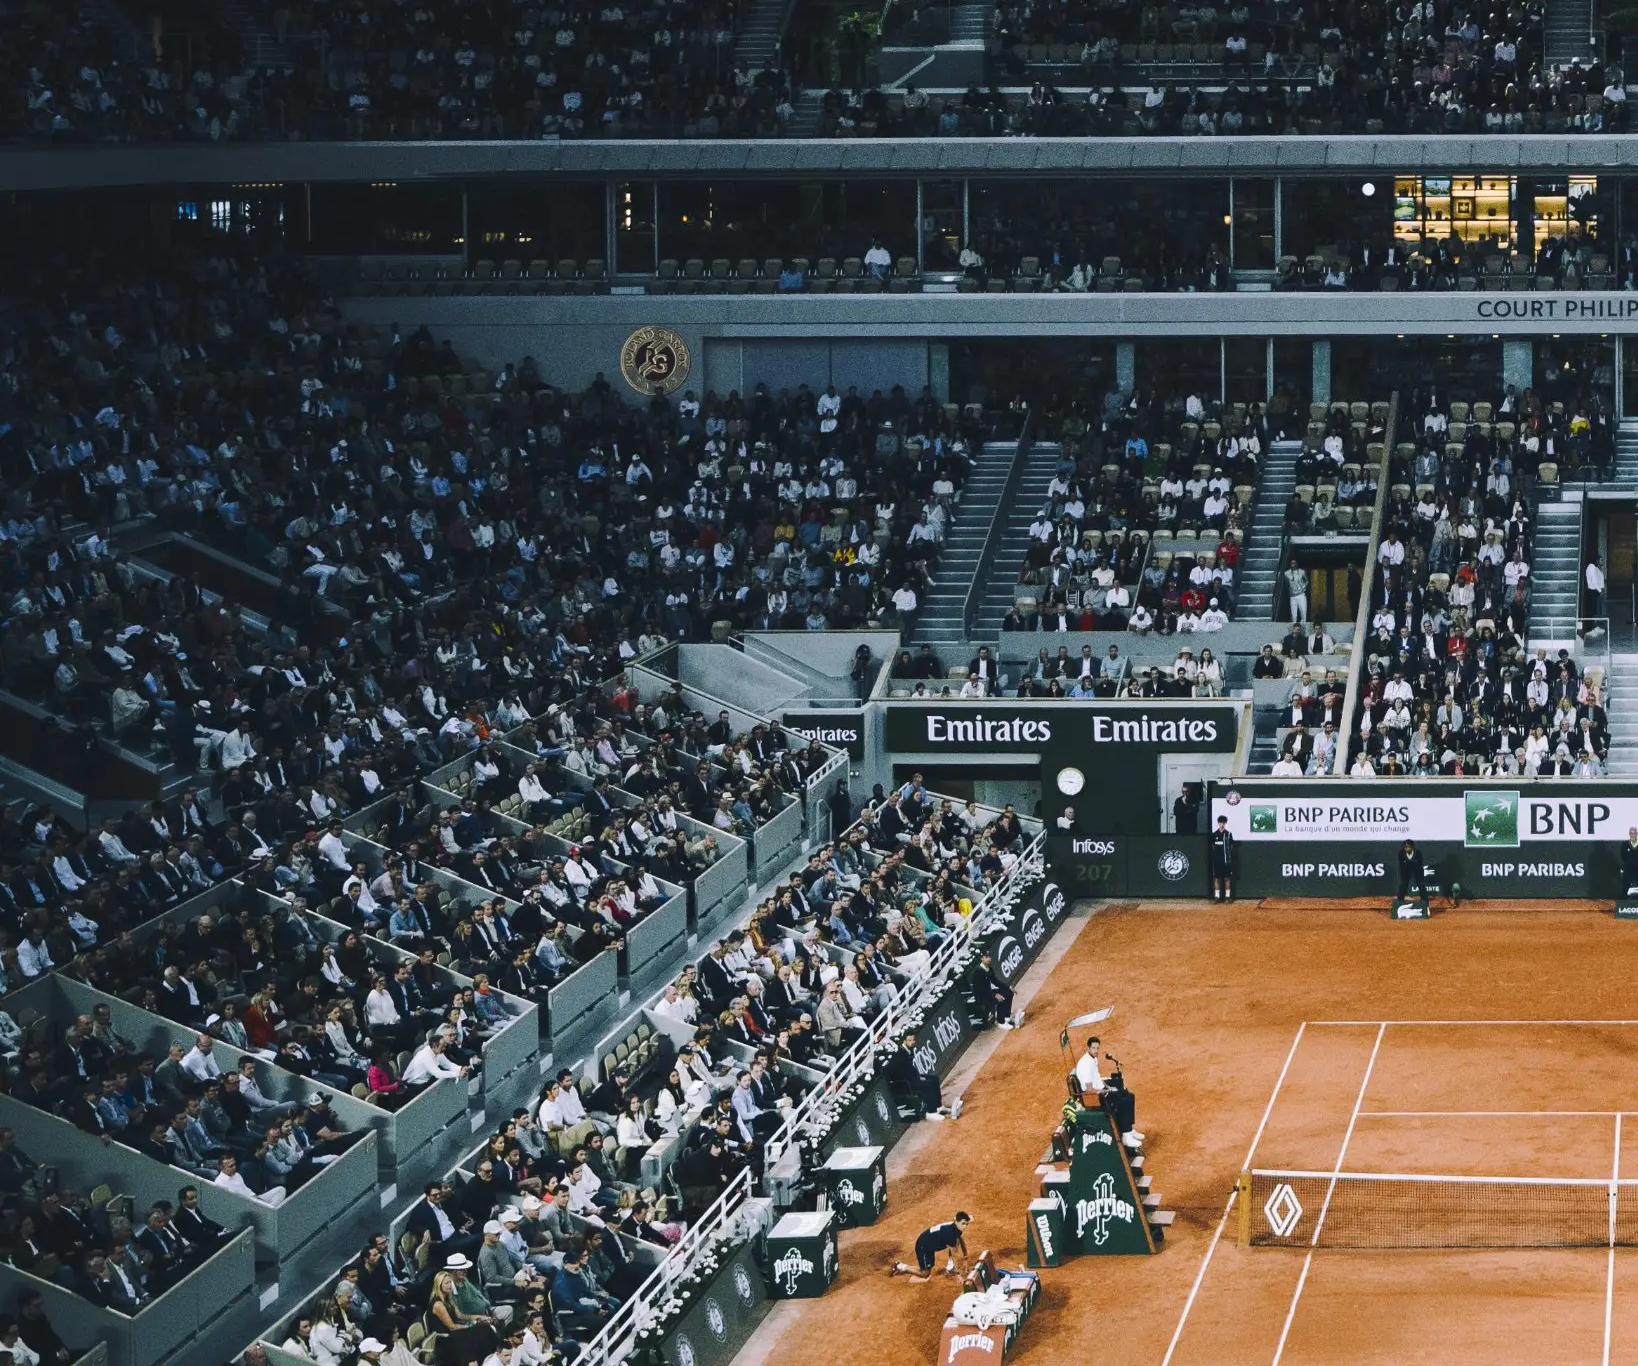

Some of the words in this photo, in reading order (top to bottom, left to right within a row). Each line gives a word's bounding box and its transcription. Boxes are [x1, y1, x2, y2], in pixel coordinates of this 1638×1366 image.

[1477, 300, 1558, 317] COURT
[926, 714, 1052, 743] Emirates
[1092, 714, 1218, 743] Emirates
[1284, 806, 1324, 823] BNP
[1329, 806, 1410, 823] PARIBAS
[1530, 803, 1611, 835] BNP
[1073, 838, 1115, 856] Infosys
[1076, 864, 1113, 881] 207
[1282, 863, 1315, 877] BNP
[1318, 863, 1385, 877] PARIBAS
[1481, 863, 1515, 877] BNP
[1518, 863, 1585, 877] PARIBAS
[932, 1010, 961, 1053] Infosys
[1035, 1213, 1055, 1259] Wilson
